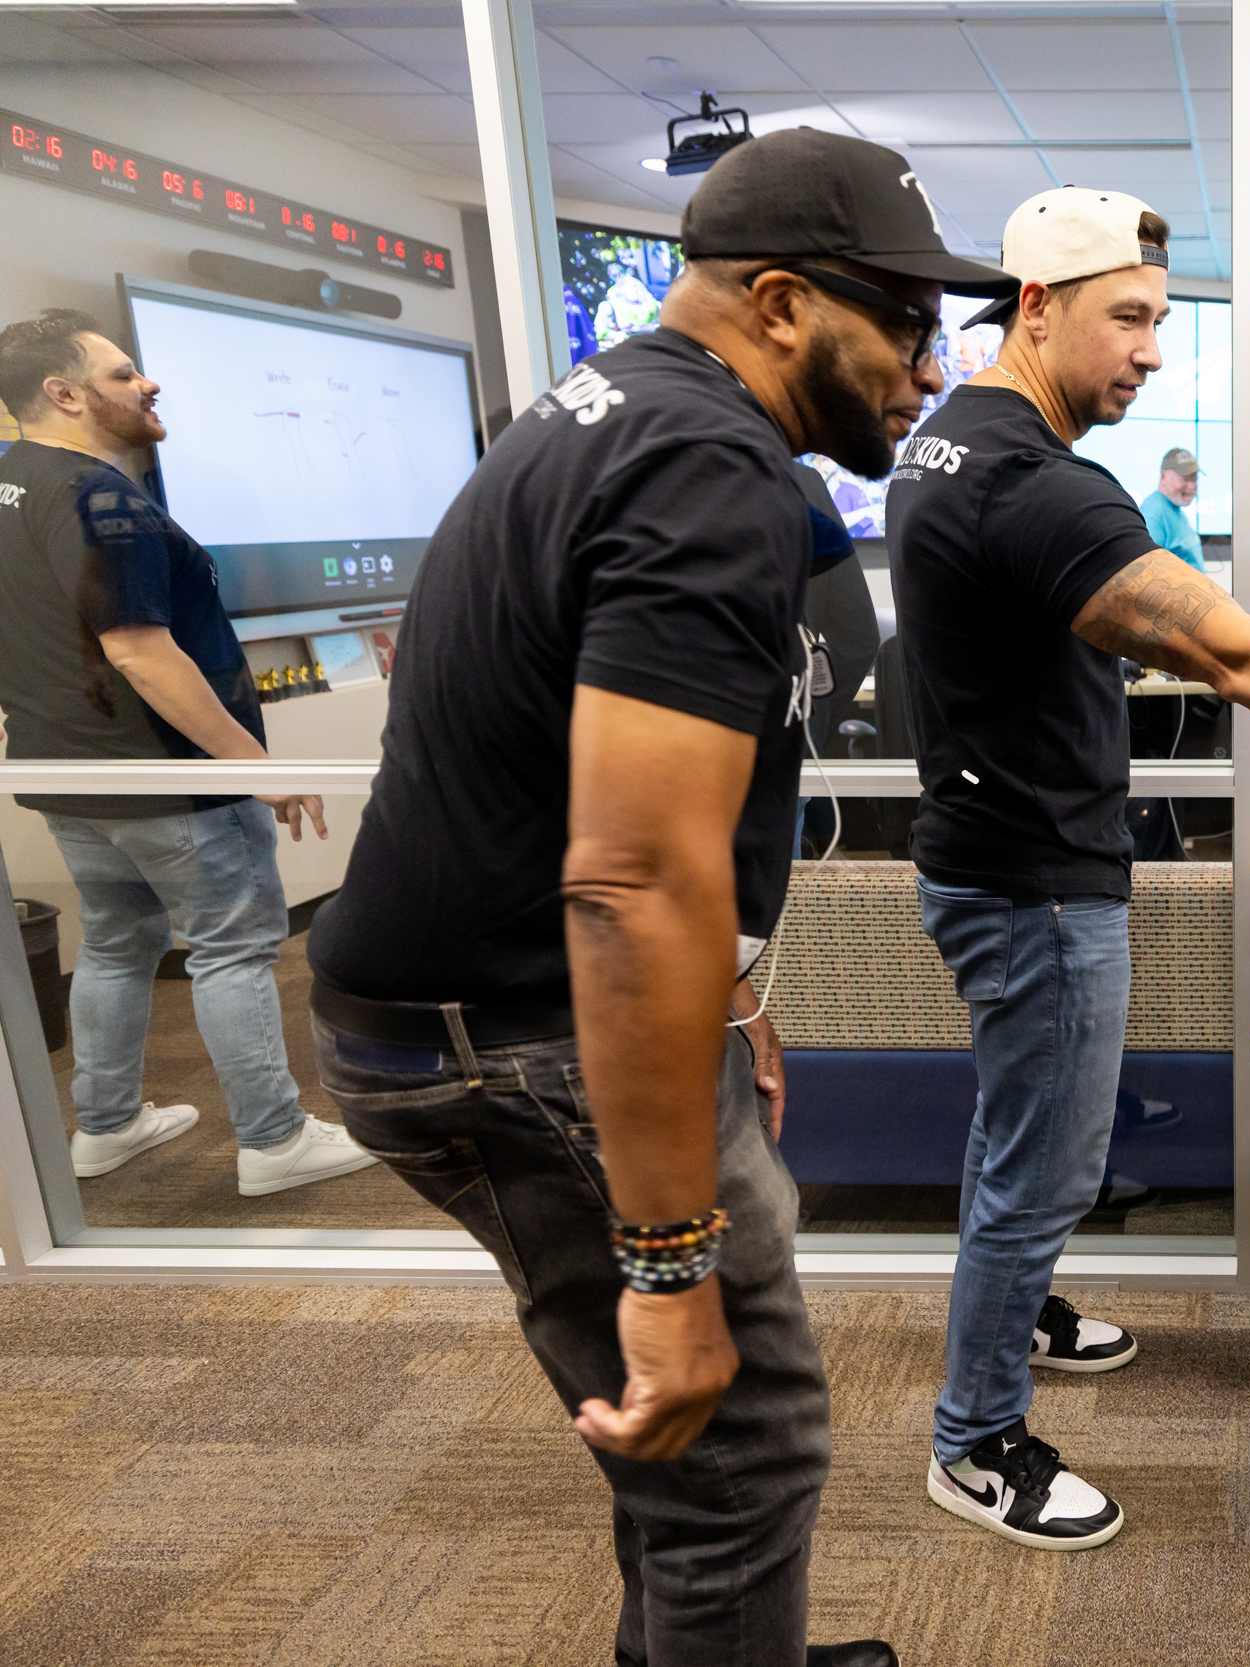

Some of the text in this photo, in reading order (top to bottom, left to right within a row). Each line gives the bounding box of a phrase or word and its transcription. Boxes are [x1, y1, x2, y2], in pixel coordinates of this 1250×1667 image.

[12, 125, 137, 180] 02:16 04:16
[22, 154, 60, 172] HAWAII
[101, 176, 136, 194] ALASKA
[265, 369, 291, 385] Write
[327, 377, 350, 392] Erase
